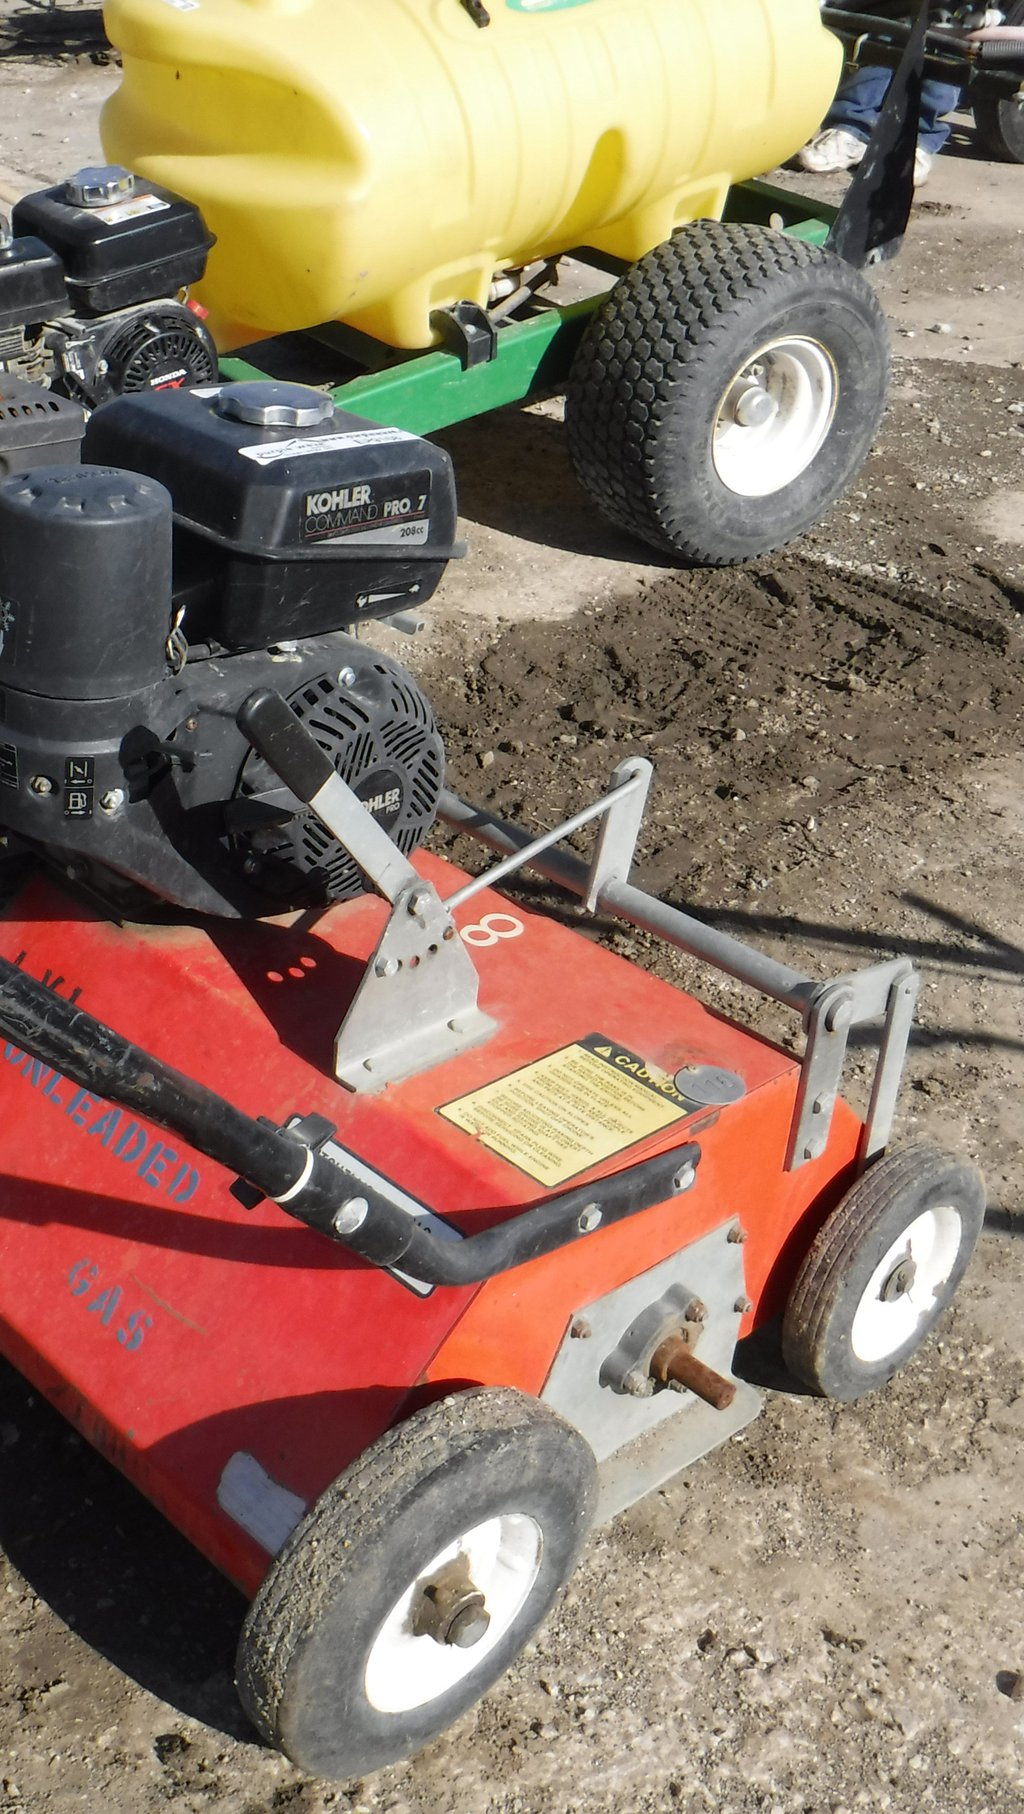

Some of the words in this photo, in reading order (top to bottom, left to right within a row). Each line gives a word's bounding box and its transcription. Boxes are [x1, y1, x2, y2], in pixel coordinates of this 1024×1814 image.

[150, 369, 187, 386] HONDA
[304, 504, 378, 533] COMMAND
[383, 498, 411, 517] PRO
[417, 495, 427, 511] 7
[306, 484, 372, 516] KOHLER
[400, 526, 424, 538] 208cc
[67, 1257, 154, 1351] GAS
